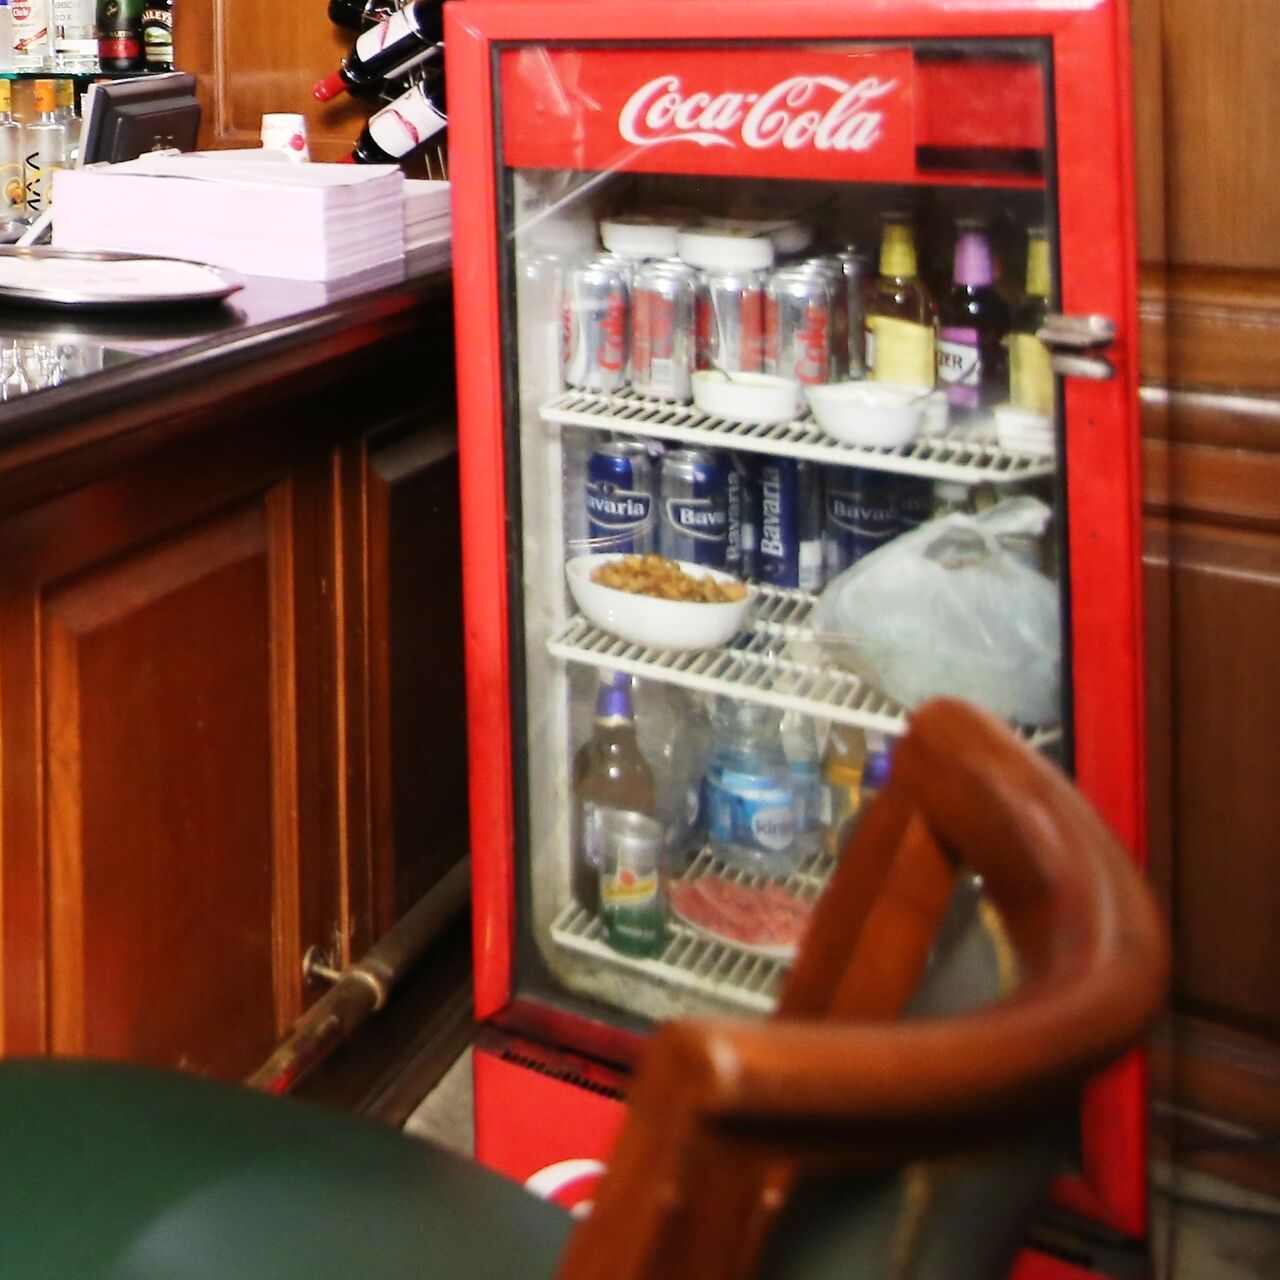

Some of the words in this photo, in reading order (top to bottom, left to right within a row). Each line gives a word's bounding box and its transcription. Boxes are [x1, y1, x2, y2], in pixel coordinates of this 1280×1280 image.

[618, 73, 899, 151] Coca-Cola
[794, 306, 828, 385] Coke
[588, 497, 646, 516] avaria
[679, 506, 725, 525] Bav
[760, 468, 785, 557] Bavaria
